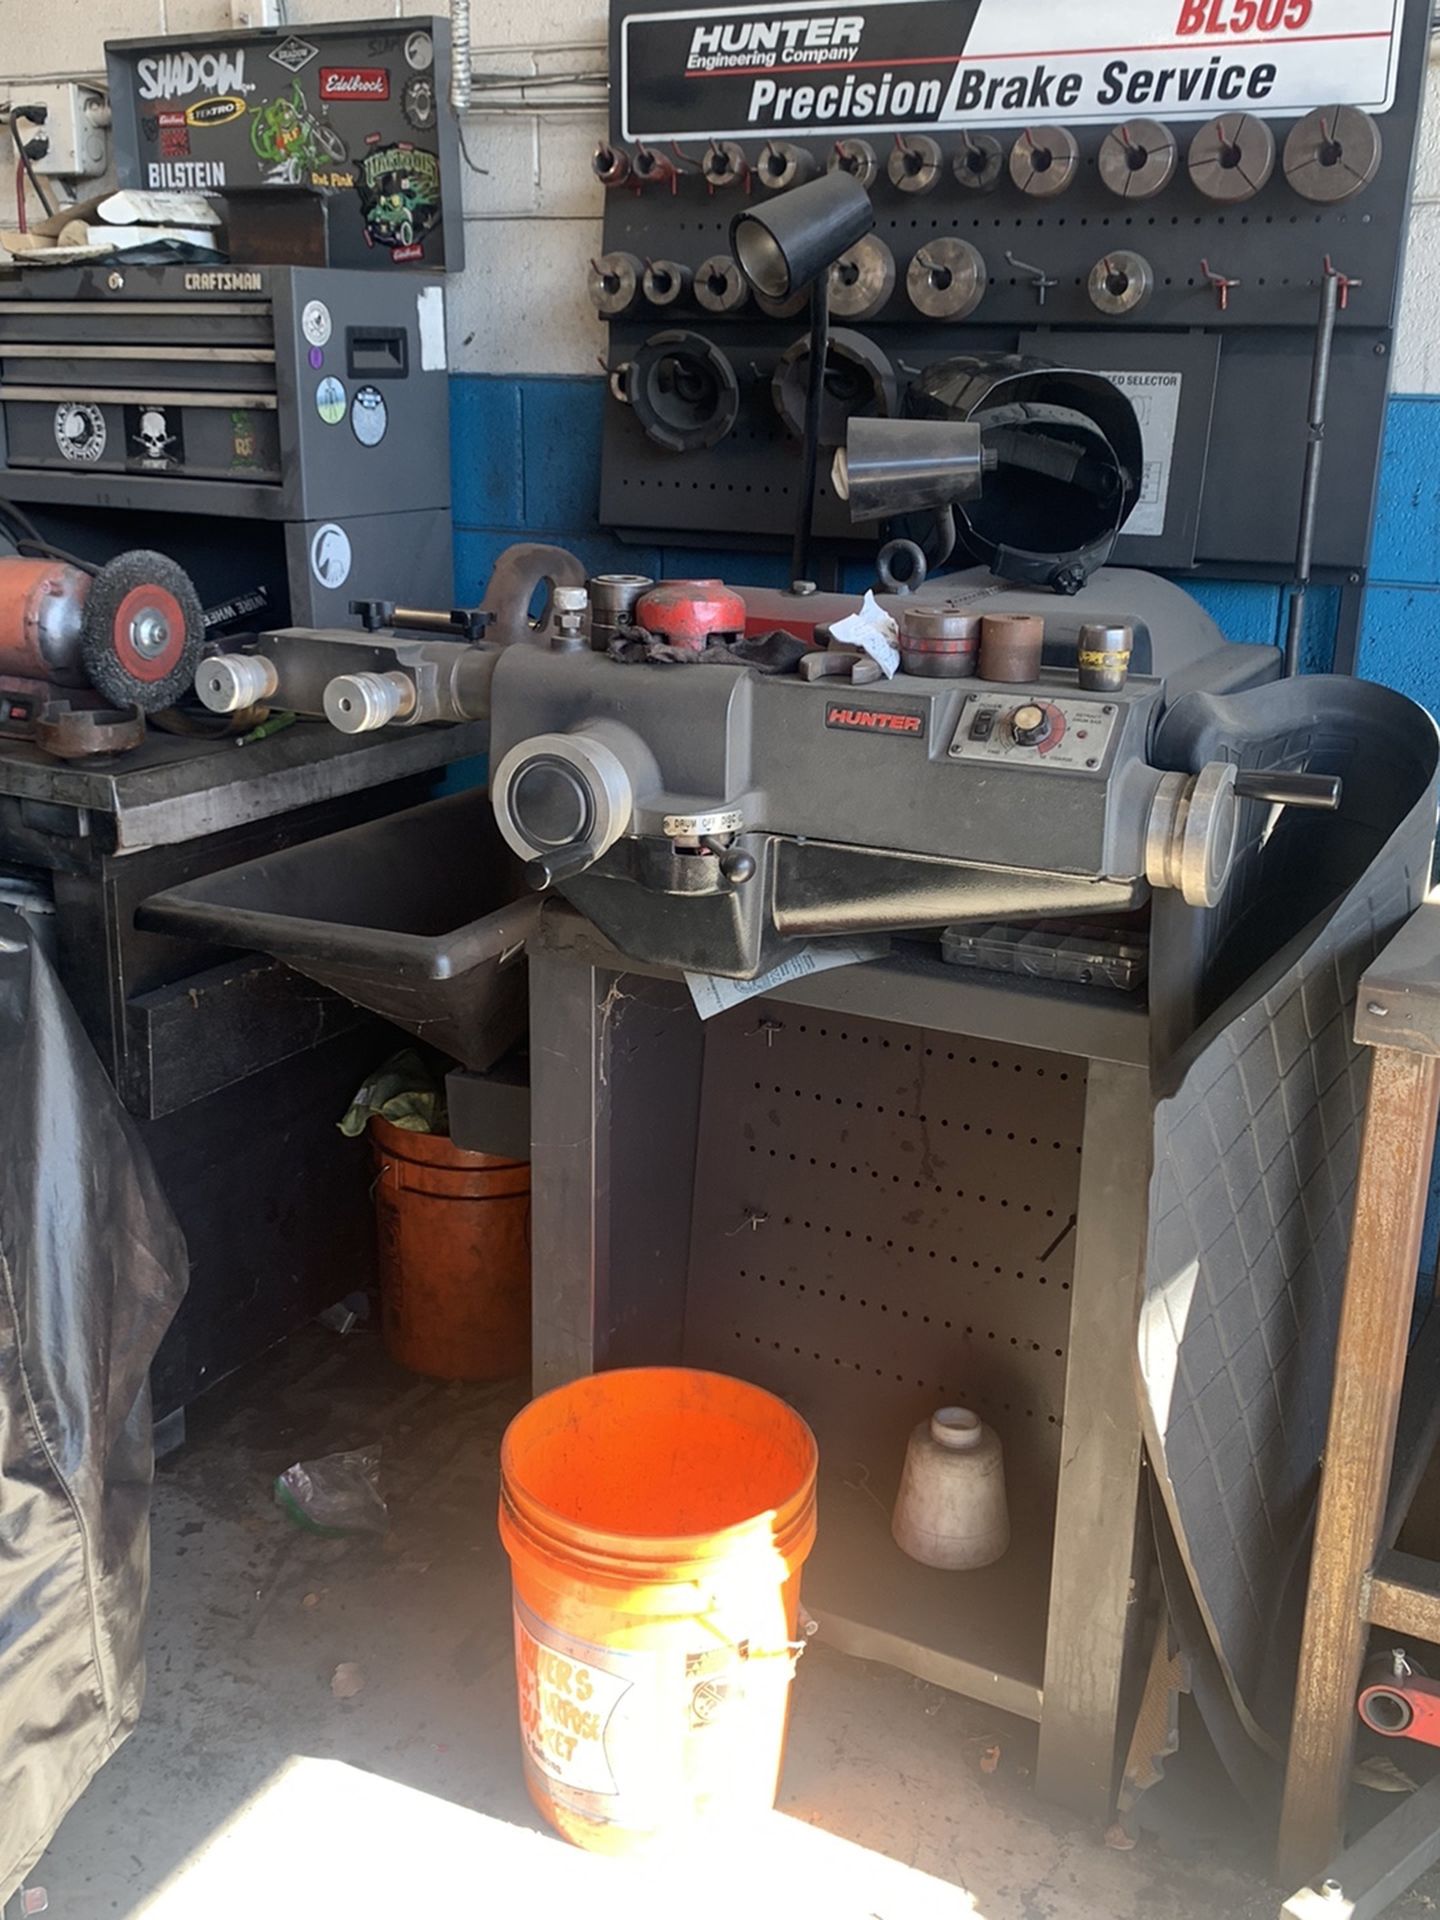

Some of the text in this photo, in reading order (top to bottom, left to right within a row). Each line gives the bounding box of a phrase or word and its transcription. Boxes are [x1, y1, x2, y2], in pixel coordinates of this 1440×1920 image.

[1175, 0, 1314, 36] BL505
[690, 16, 865, 53] HUNTER
[686, 45, 859, 71] Engineering Company
[137, 49, 244, 100] SHADOW
[326, 74, 385, 93] Edelbrock
[748, 56, 1278, 121] Precision Brake Service
[148, 161, 226, 188] BILSTEIN
[185, 272, 262, 291] CRAFTSMAN
[1126, 375, 1178, 386] SELECTOR
[201, 605, 237, 627] WHEE
[829, 708, 921, 731] HUNTER
[674, 818, 697, 829] DRUM
